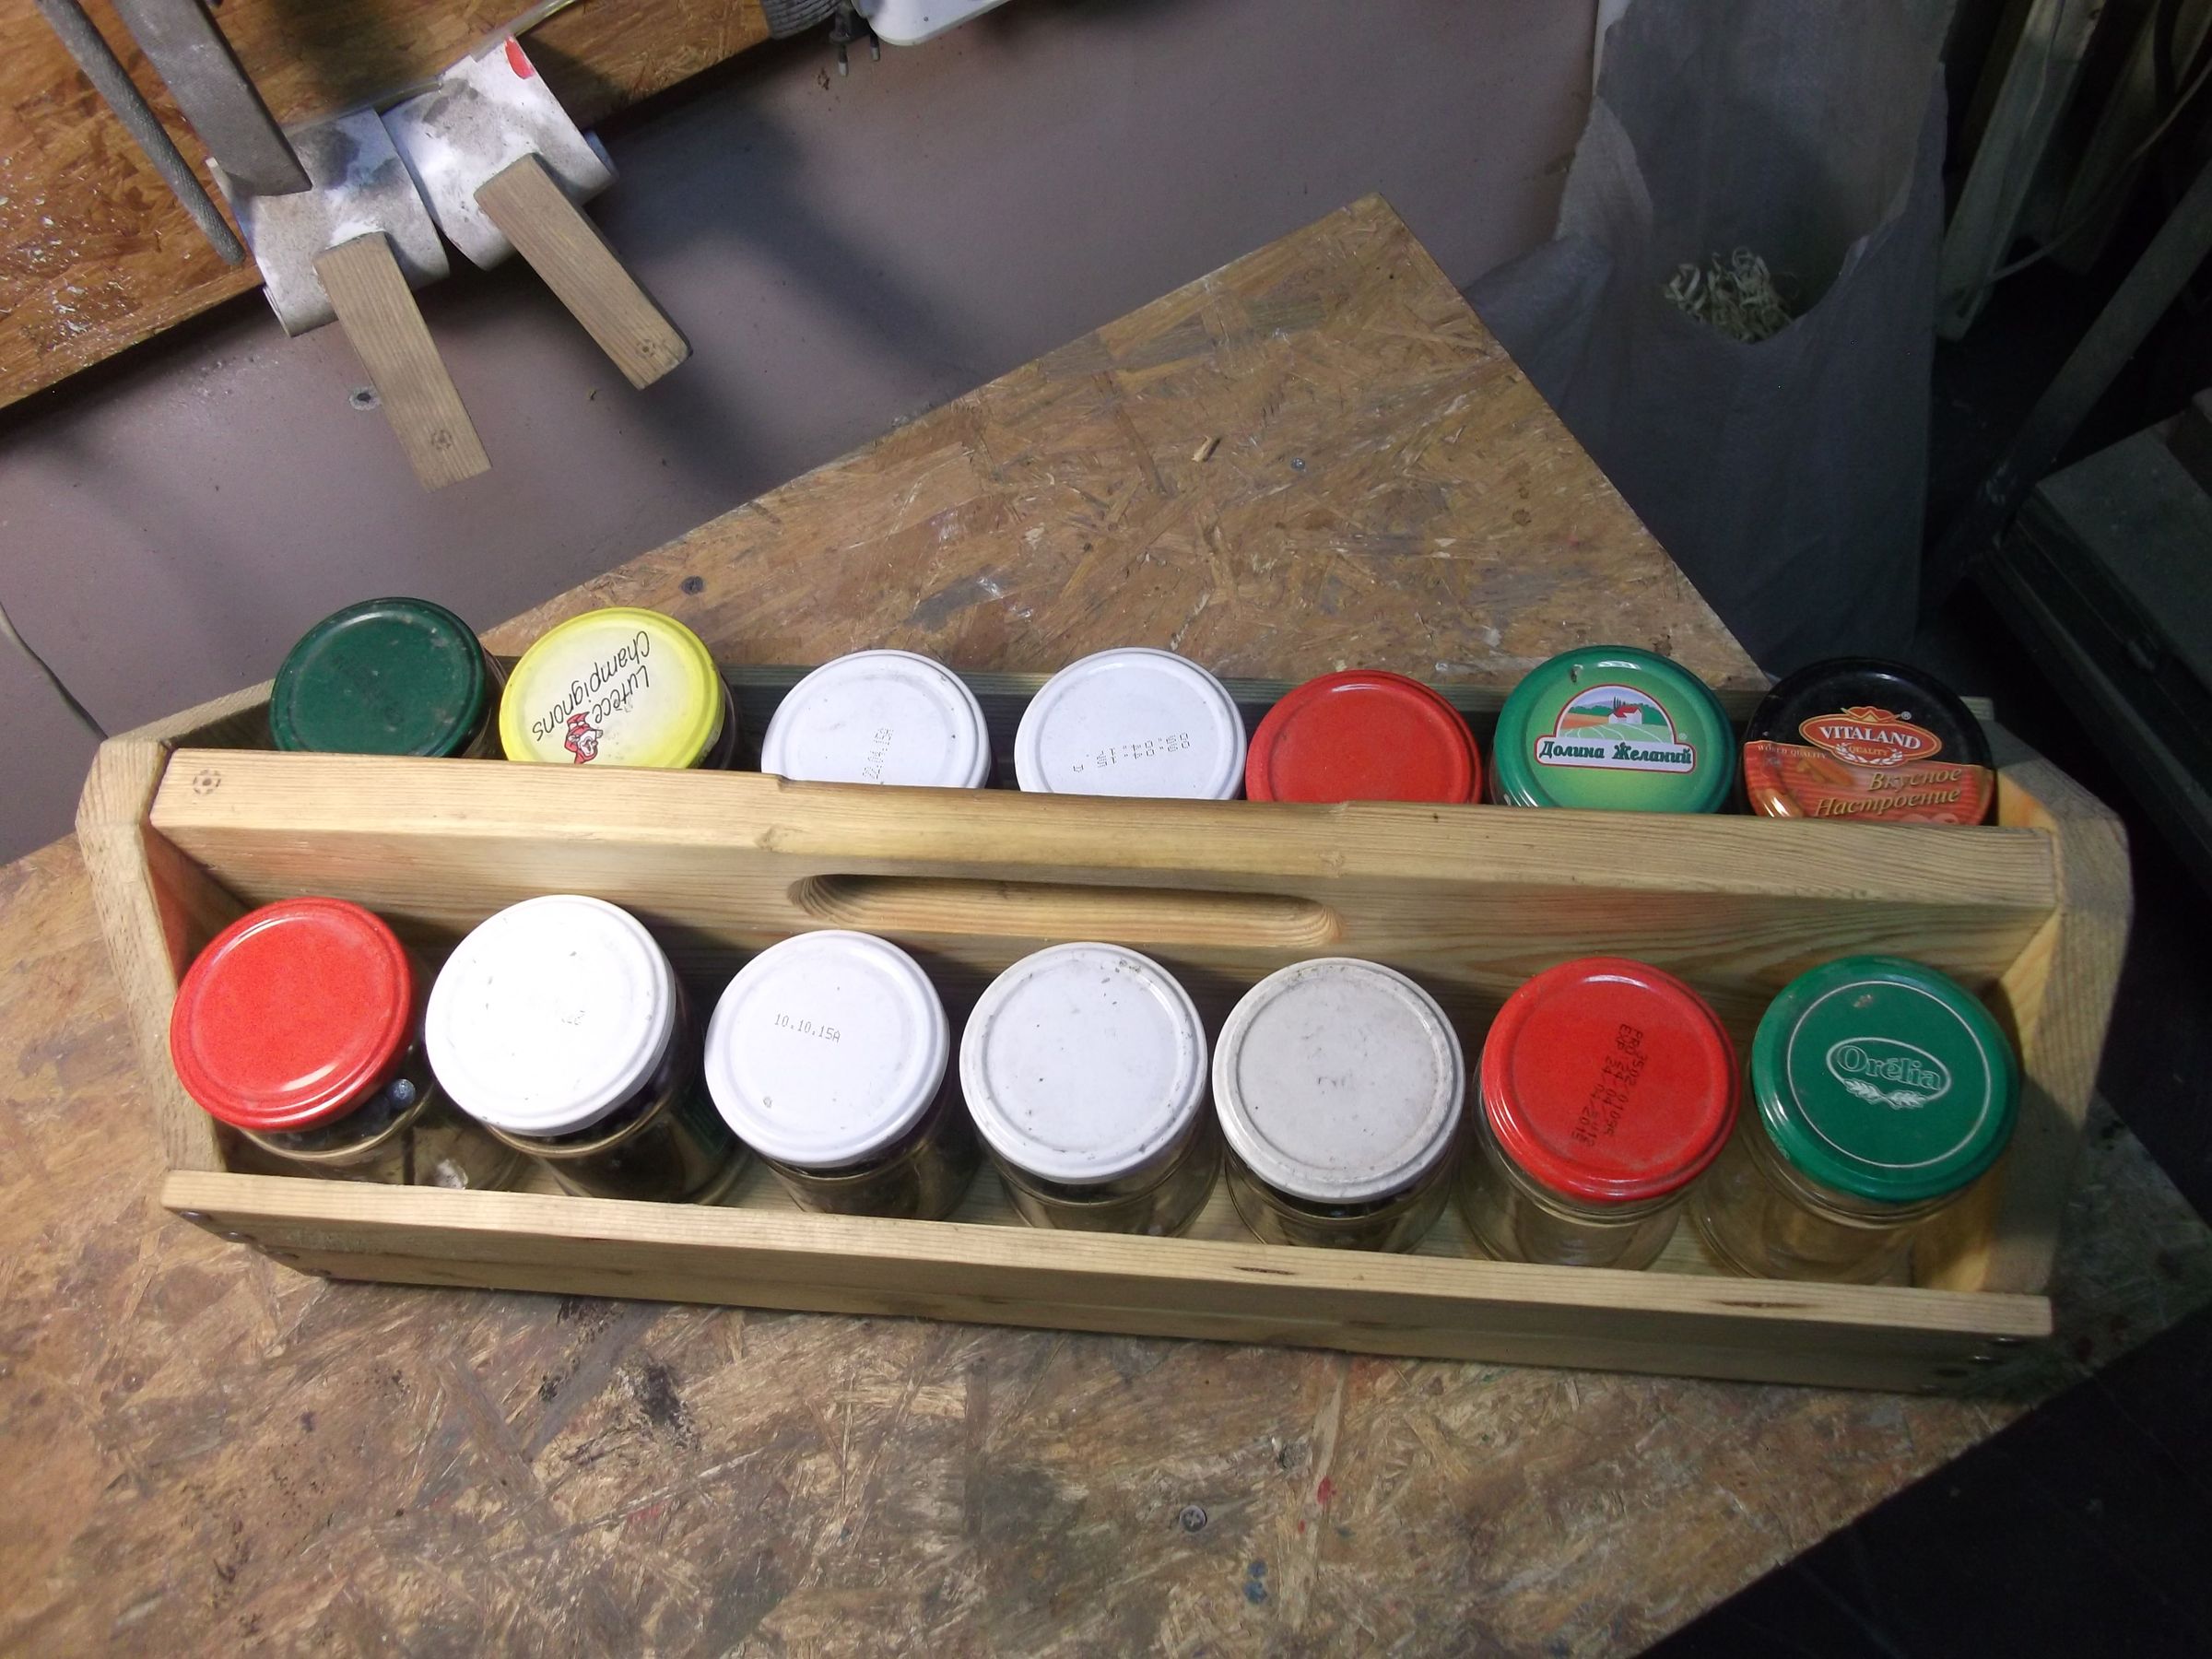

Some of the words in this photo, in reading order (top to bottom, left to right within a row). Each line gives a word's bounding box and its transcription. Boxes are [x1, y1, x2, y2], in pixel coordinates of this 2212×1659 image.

[532, 630, 651, 742] Champignons
[1818, 724, 1922, 749] VITALAND
[1539, 740, 1606, 759] Долина
[1612, 741, 1692, 764] Желаний
[1790, 748, 1826, 759] QUALITY
[1848, 745, 1888, 756] QUALITY
[1867, 768, 1962, 793] Вкусное
[1814, 788, 1961, 817] Настроение
[774, 1013, 841, 1043] 10.10.15A
